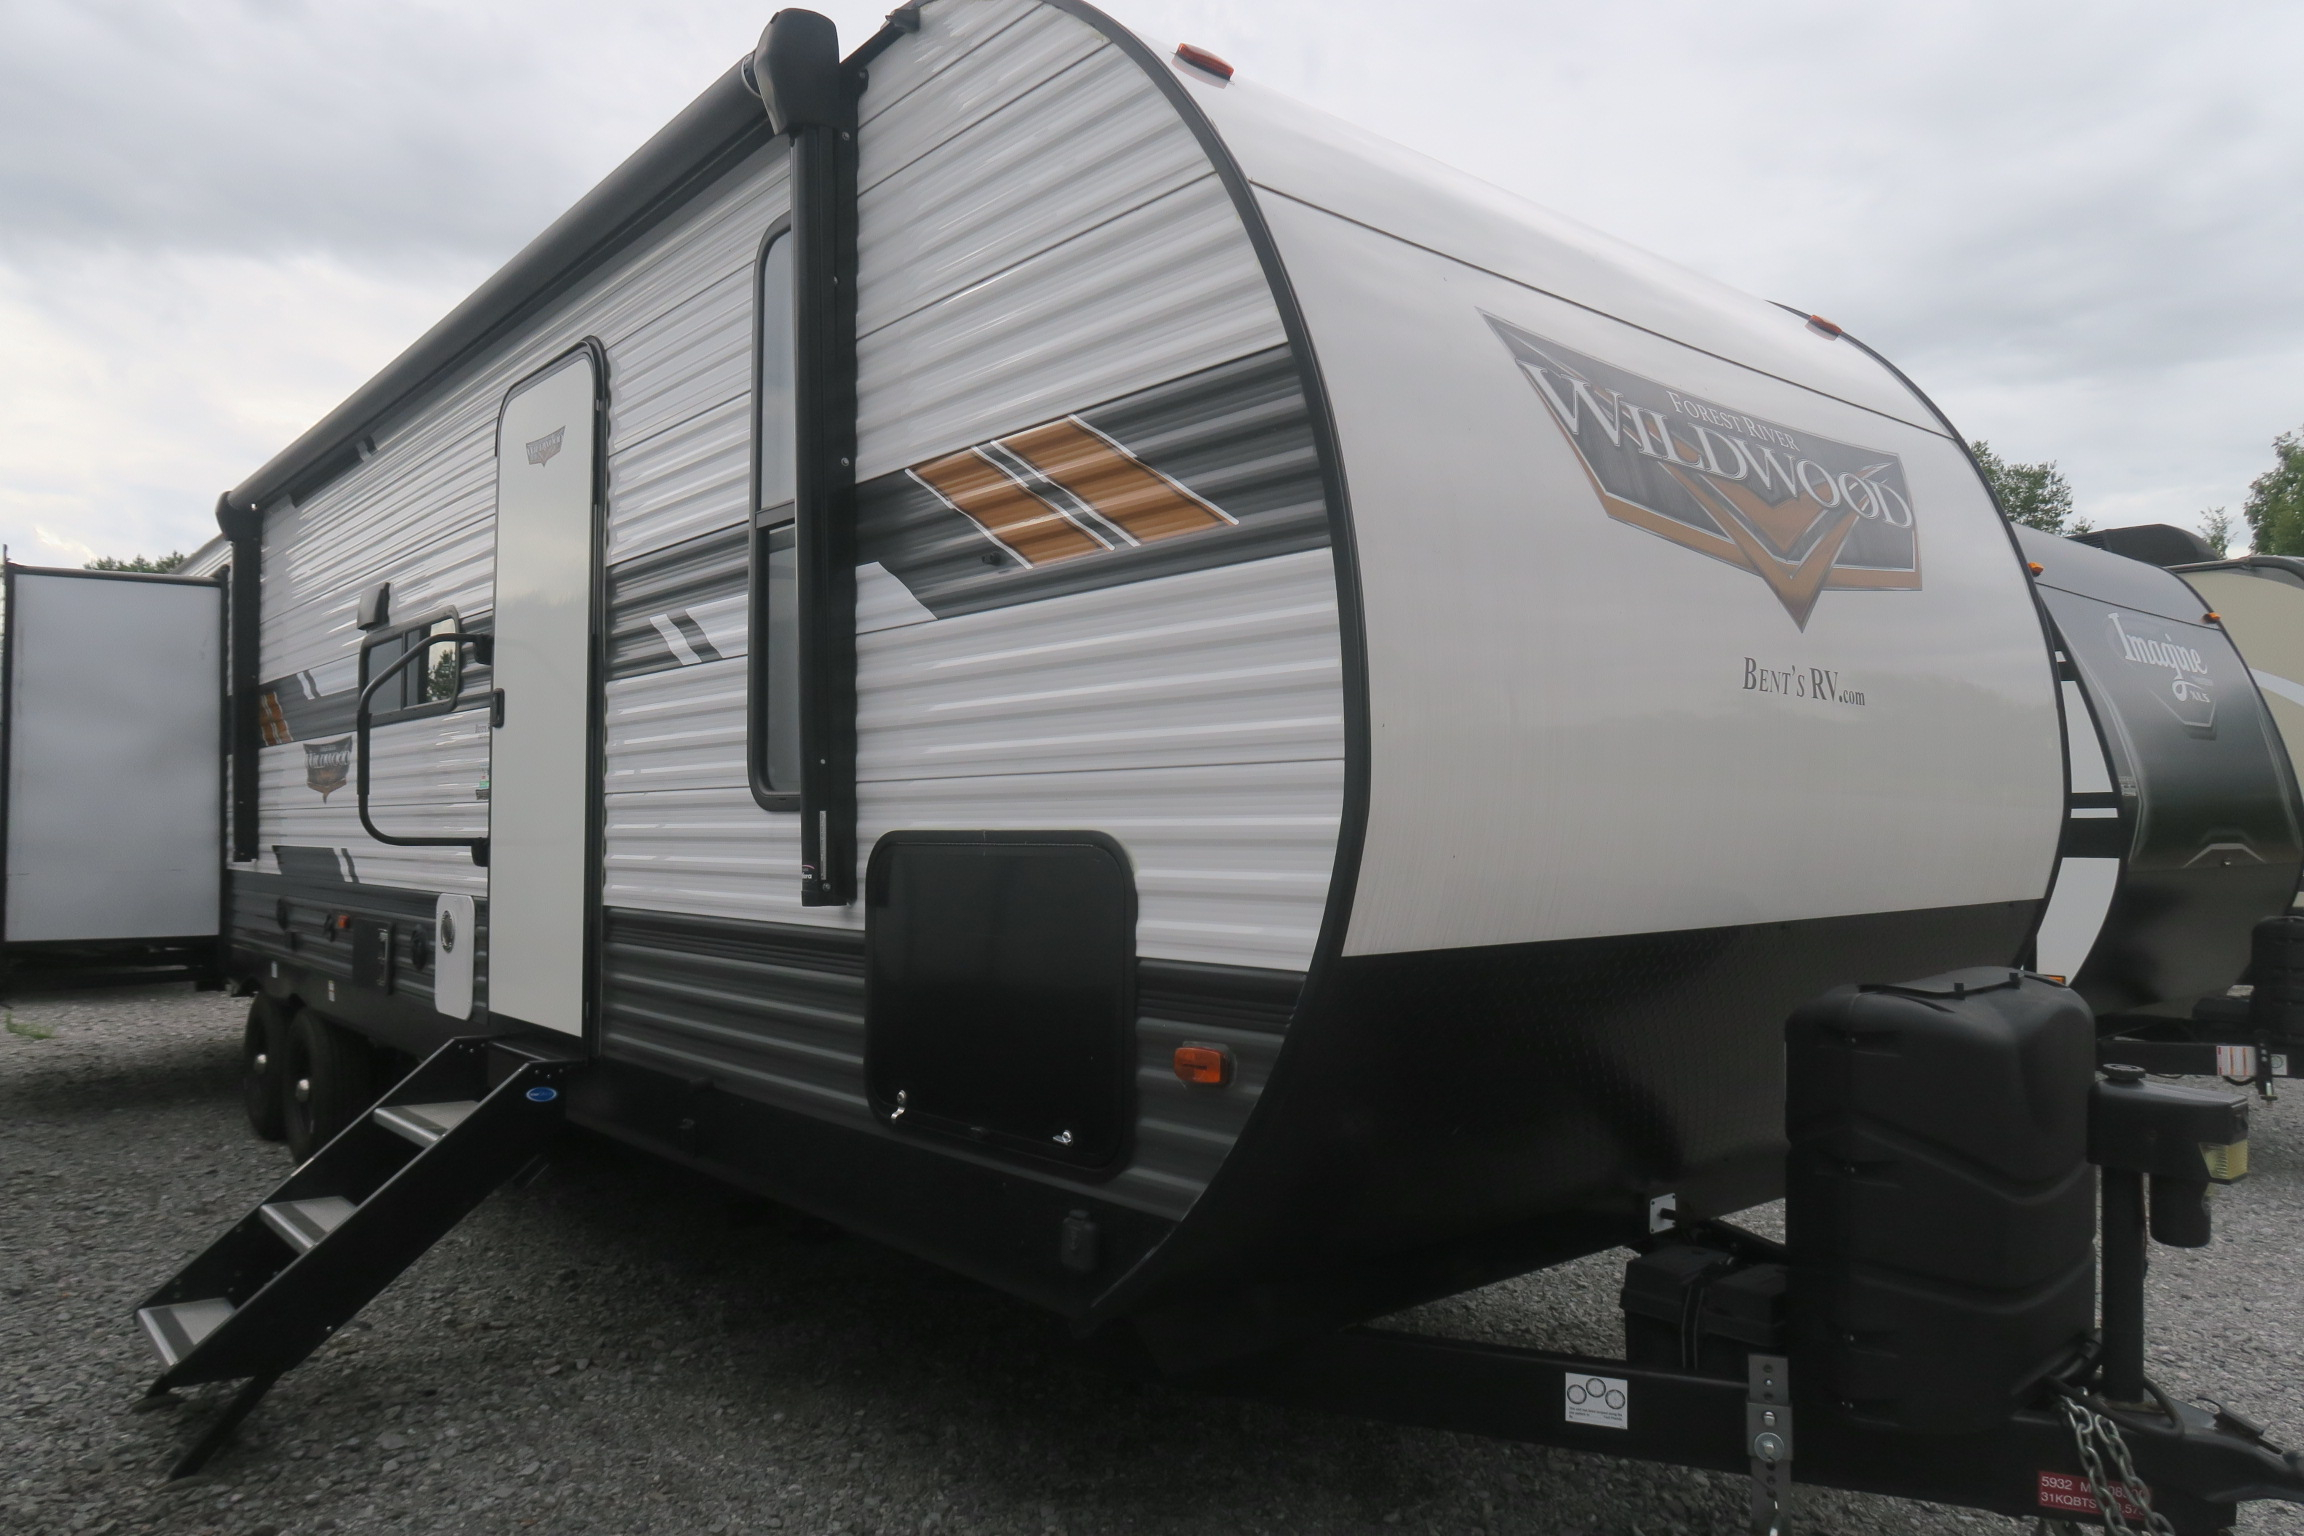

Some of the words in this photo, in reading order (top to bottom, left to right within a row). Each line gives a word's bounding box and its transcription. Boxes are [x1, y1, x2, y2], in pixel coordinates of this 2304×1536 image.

[1514, 357, 1913, 529] WILDWOOD
[1666, 390, 1742, 433] FOREST
[1741, 415, 1801, 452] RIVER
[2107, 612, 2208, 701] Imagine
[1809, 667, 1866, 706] RV.com
[2041, 1476, 2072, 1490] 5932
[2041, 1492, 2097, 1508] 31KQBTS
